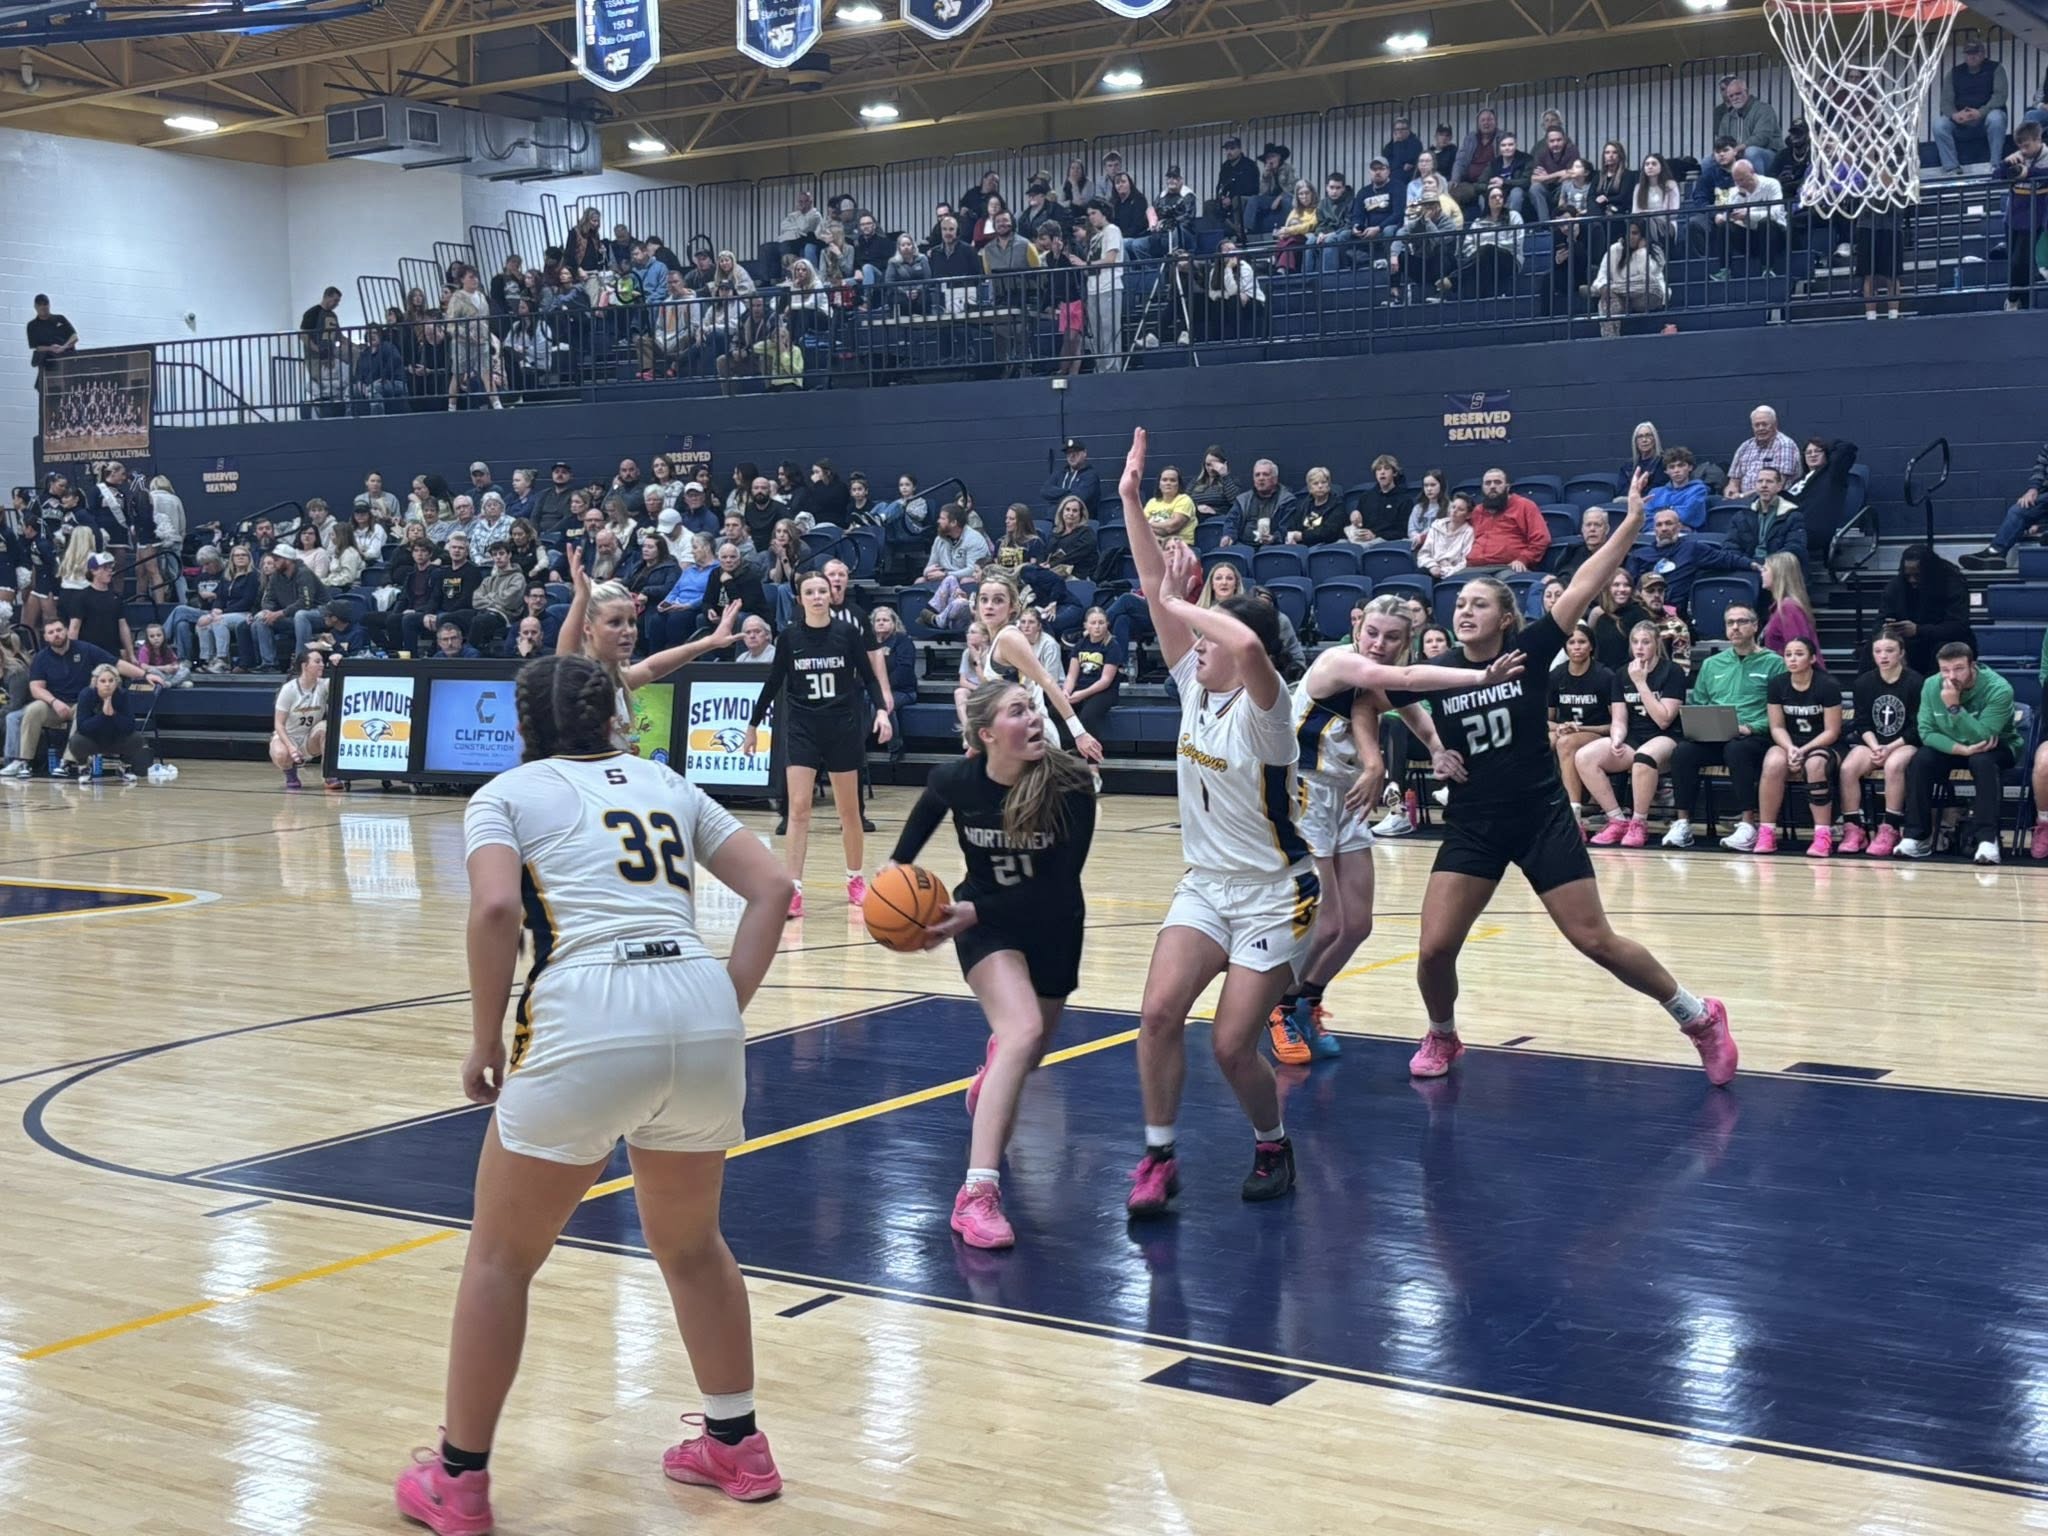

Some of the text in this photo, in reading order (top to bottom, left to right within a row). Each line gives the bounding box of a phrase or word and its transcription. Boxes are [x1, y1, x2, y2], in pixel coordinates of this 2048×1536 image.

[1444, 410, 1512, 426] RESERVED
[1448, 426, 1507, 441] SEATING
[111, 447, 151, 459] VOLLEYBALL
[203, 471, 239, 482] RESERVED
[205, 482, 238, 493] SEATING
[794, 656, 845, 671] NORTHVIEW
[805, 673, 836, 700] 30
[1441, 680, 1523, 716] NORTHVIEW
[1558, 693, 1598, 705] NORTHVIEW
[455, 728, 516, 743] CLIFTON
[1461, 707, 1512, 756] 20
[339, 743, 410, 759] BASKETBALL
[454, 742, 515, 752] CONSTRUCTION
[687, 755, 772, 772] BASKETBALL
[1200, 777, 1211, 812] 1
[602, 810, 691, 896] 32
[990, 853, 1034, 886] 21
